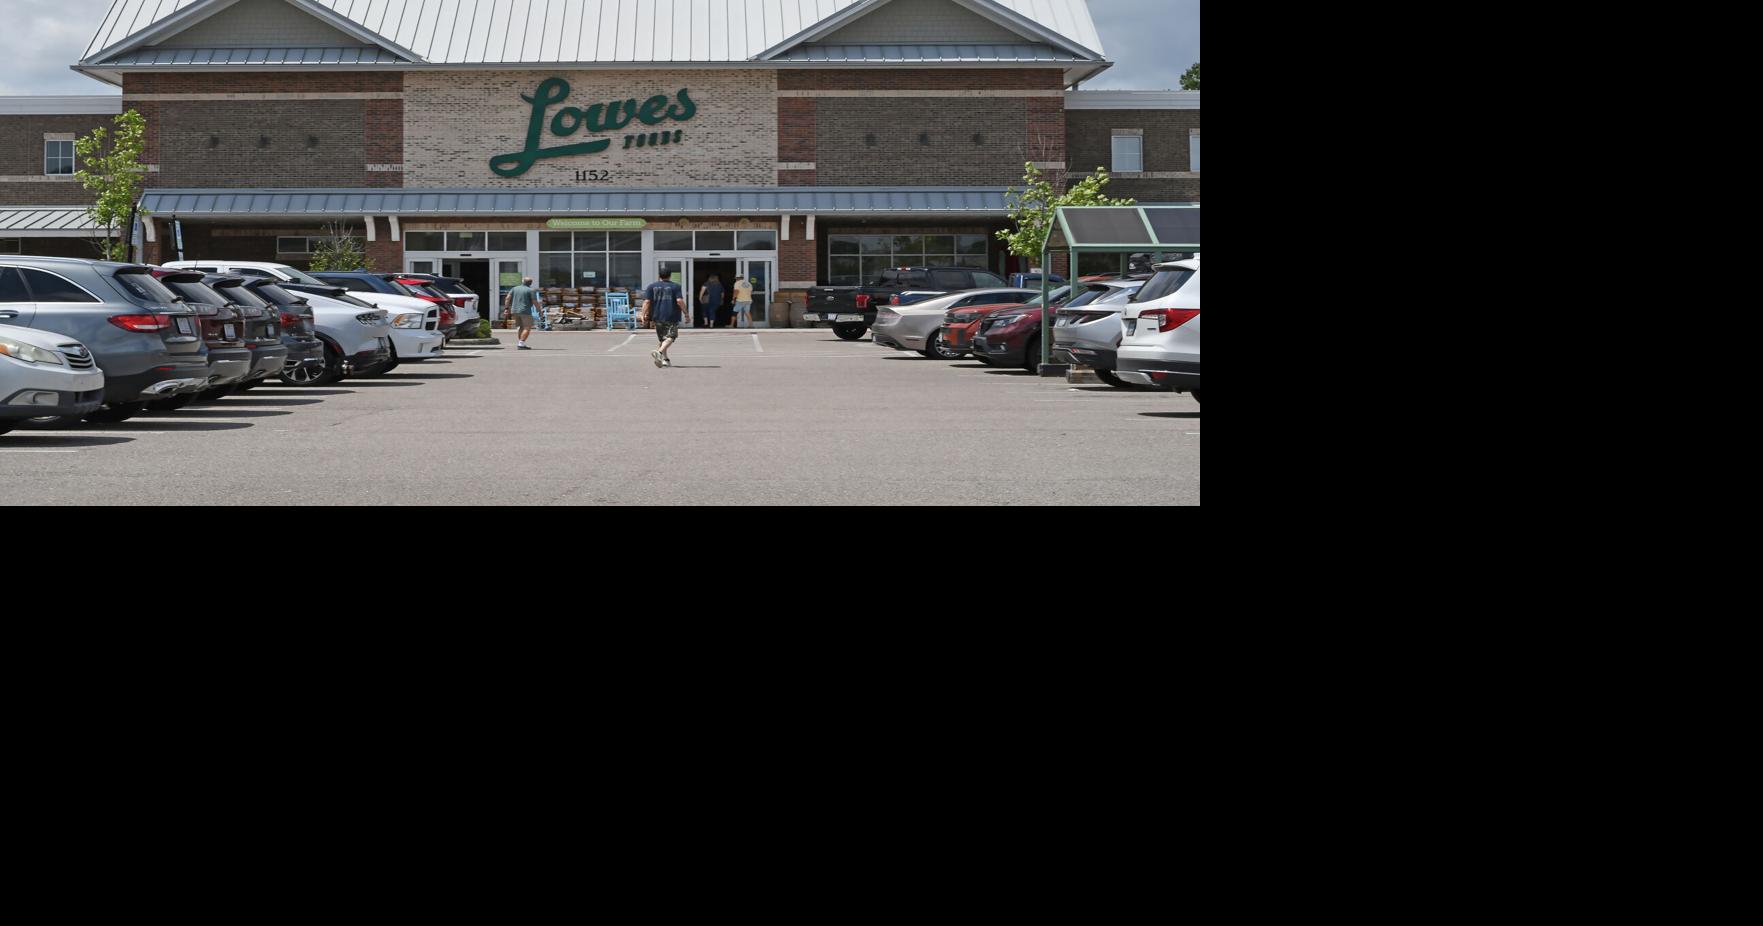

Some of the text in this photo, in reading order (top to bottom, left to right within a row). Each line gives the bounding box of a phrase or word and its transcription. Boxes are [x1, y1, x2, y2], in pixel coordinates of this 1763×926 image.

[489, 77, 697, 178] Lowes
[575, 169, 609, 181] 1152
[552, 218, 642, 226] Welcome to Our Farm
